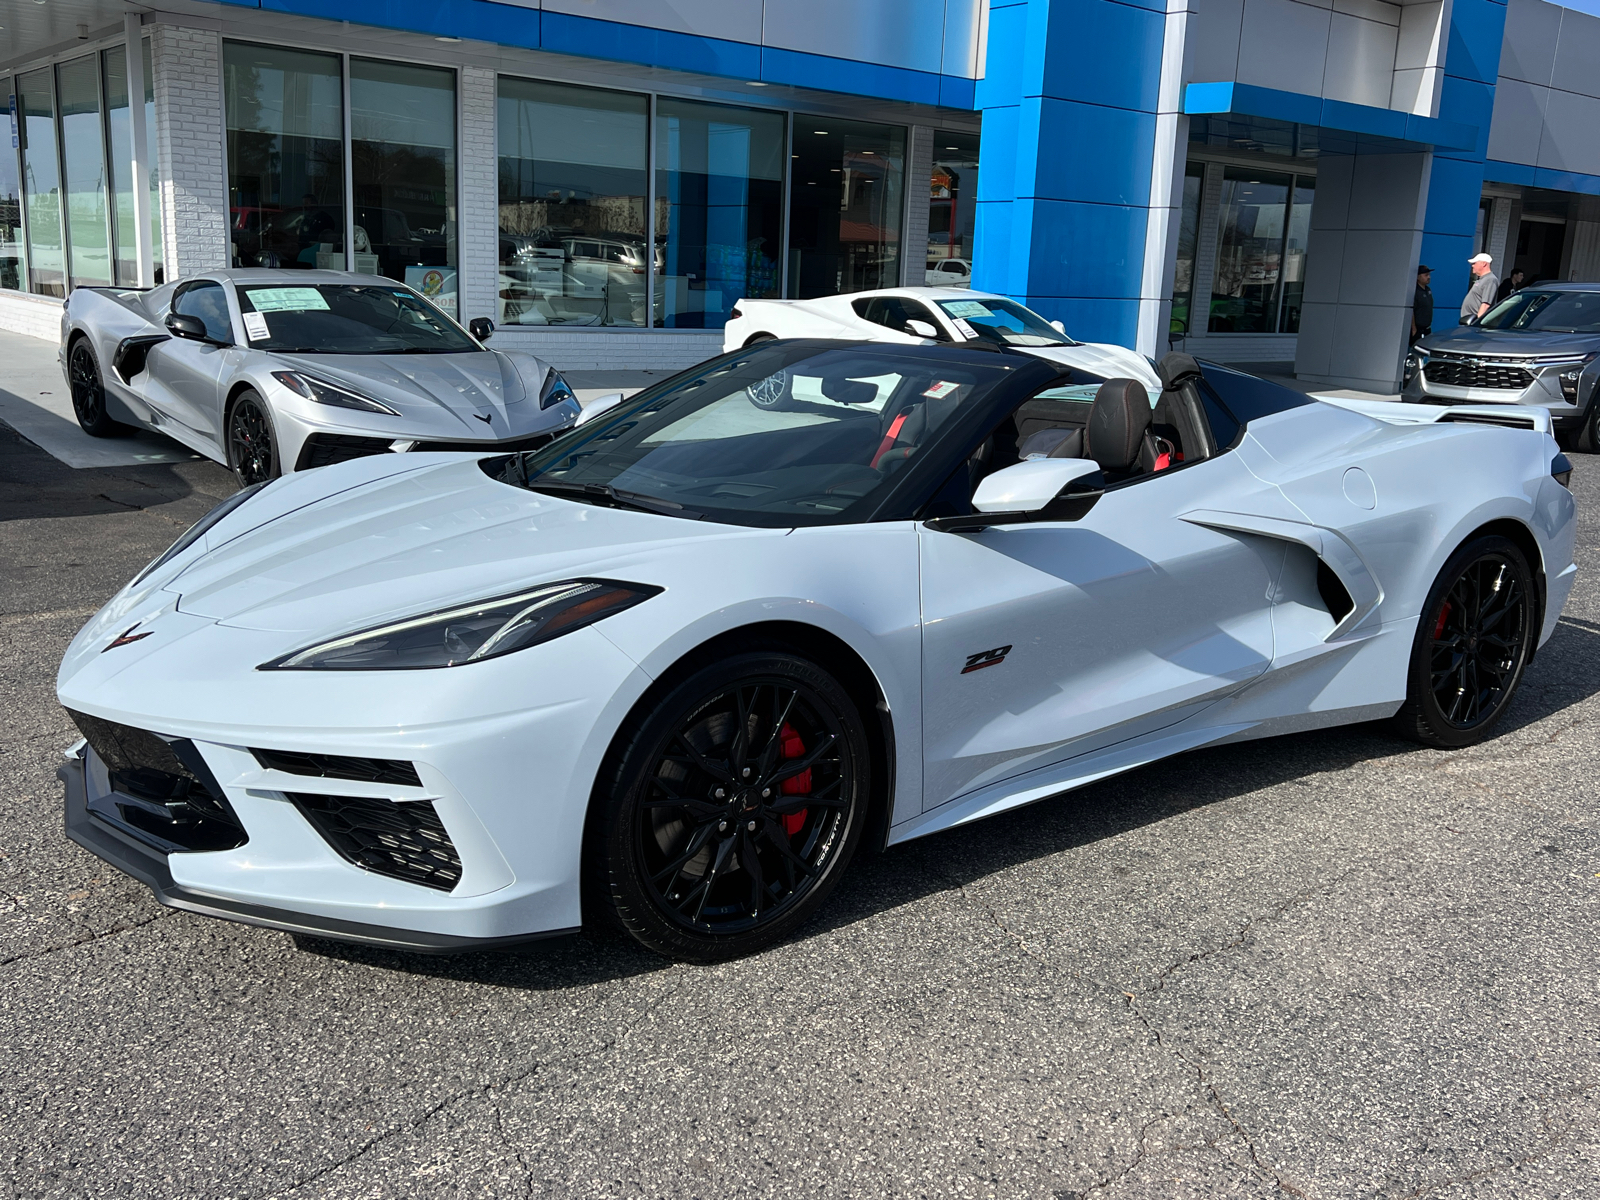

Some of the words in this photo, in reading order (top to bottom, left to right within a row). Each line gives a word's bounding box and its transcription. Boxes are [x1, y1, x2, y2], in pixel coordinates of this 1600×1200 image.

[434, 298, 455, 307] SOR
[966, 645, 1013, 667] 70
[817, 812, 841, 867] CORVETTE
